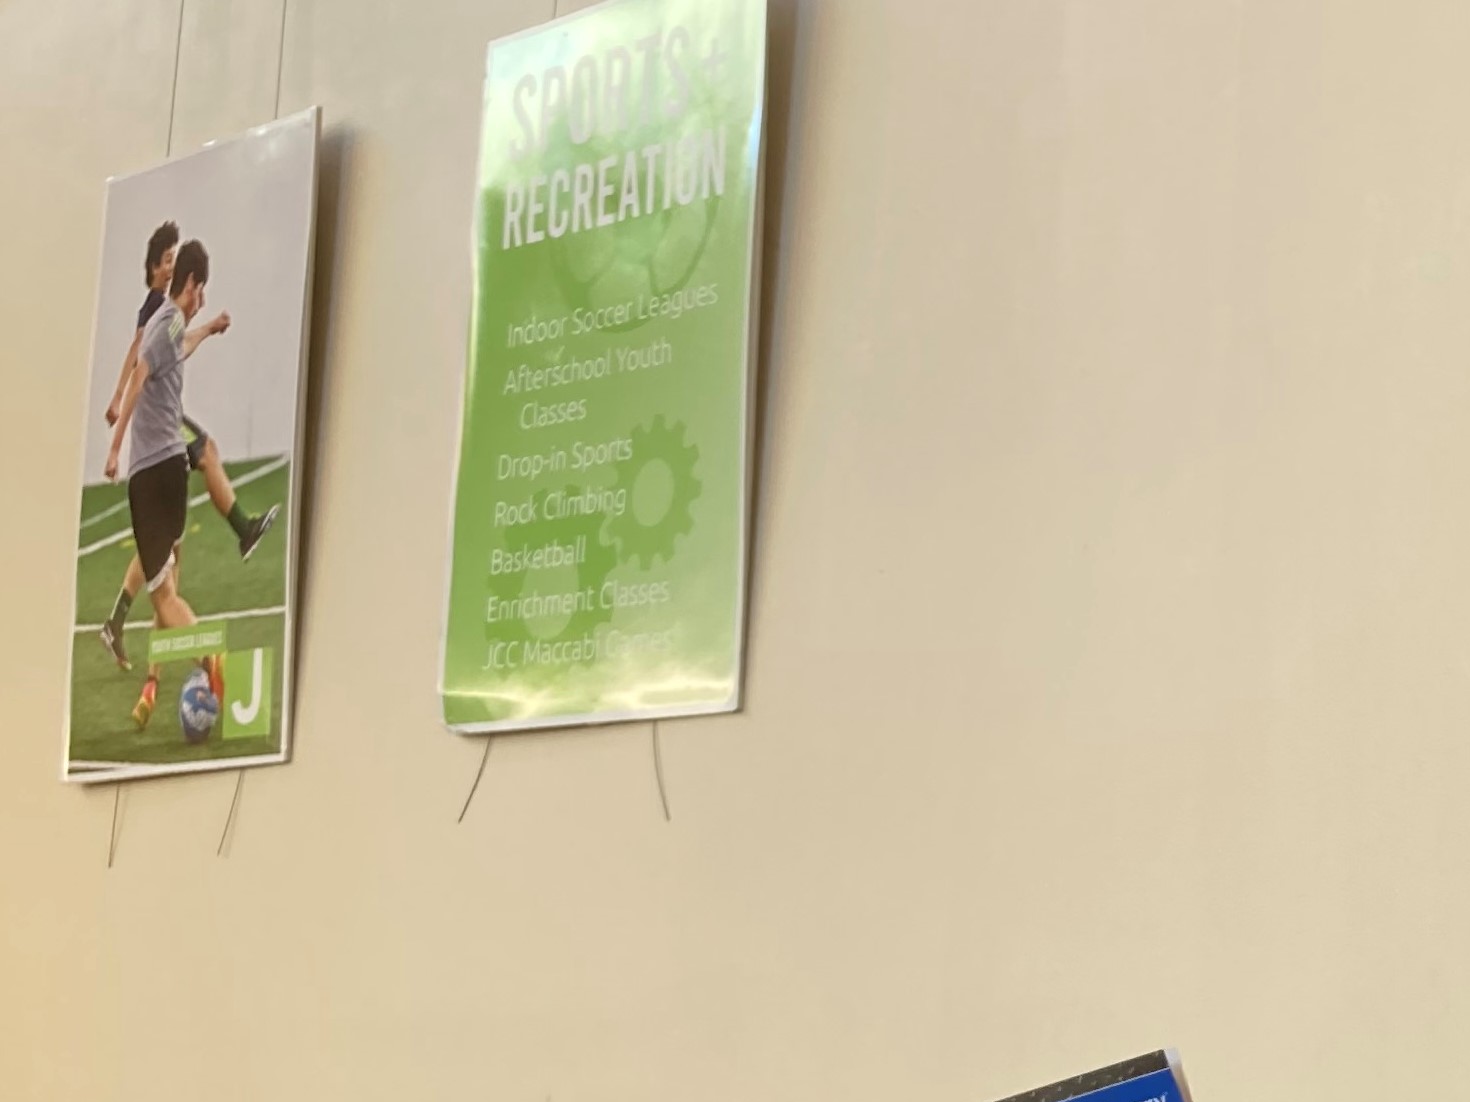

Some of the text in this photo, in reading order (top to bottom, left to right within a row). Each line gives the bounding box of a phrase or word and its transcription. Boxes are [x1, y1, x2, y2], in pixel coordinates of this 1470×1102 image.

[508, 25, 692, 160] SPORTS
[501, 124, 727, 250] RECREATION
[507, 283, 719, 349] Indoor Soccer Leagues
[503, 336, 673, 395] Afterschool Youth
[519, 398, 588, 430] Classes
[496, 438, 634, 481] Drop-in Sports
[493, 487, 627, 528] Rock Climbing
[490, 535, 587, 576] Basketball
[486, 579, 670, 623] Enrichment Classes
[482, 640, 520, 670] JCC
[523, 631, 600, 665] Maccabi
[231, 647, 263, 725] J
